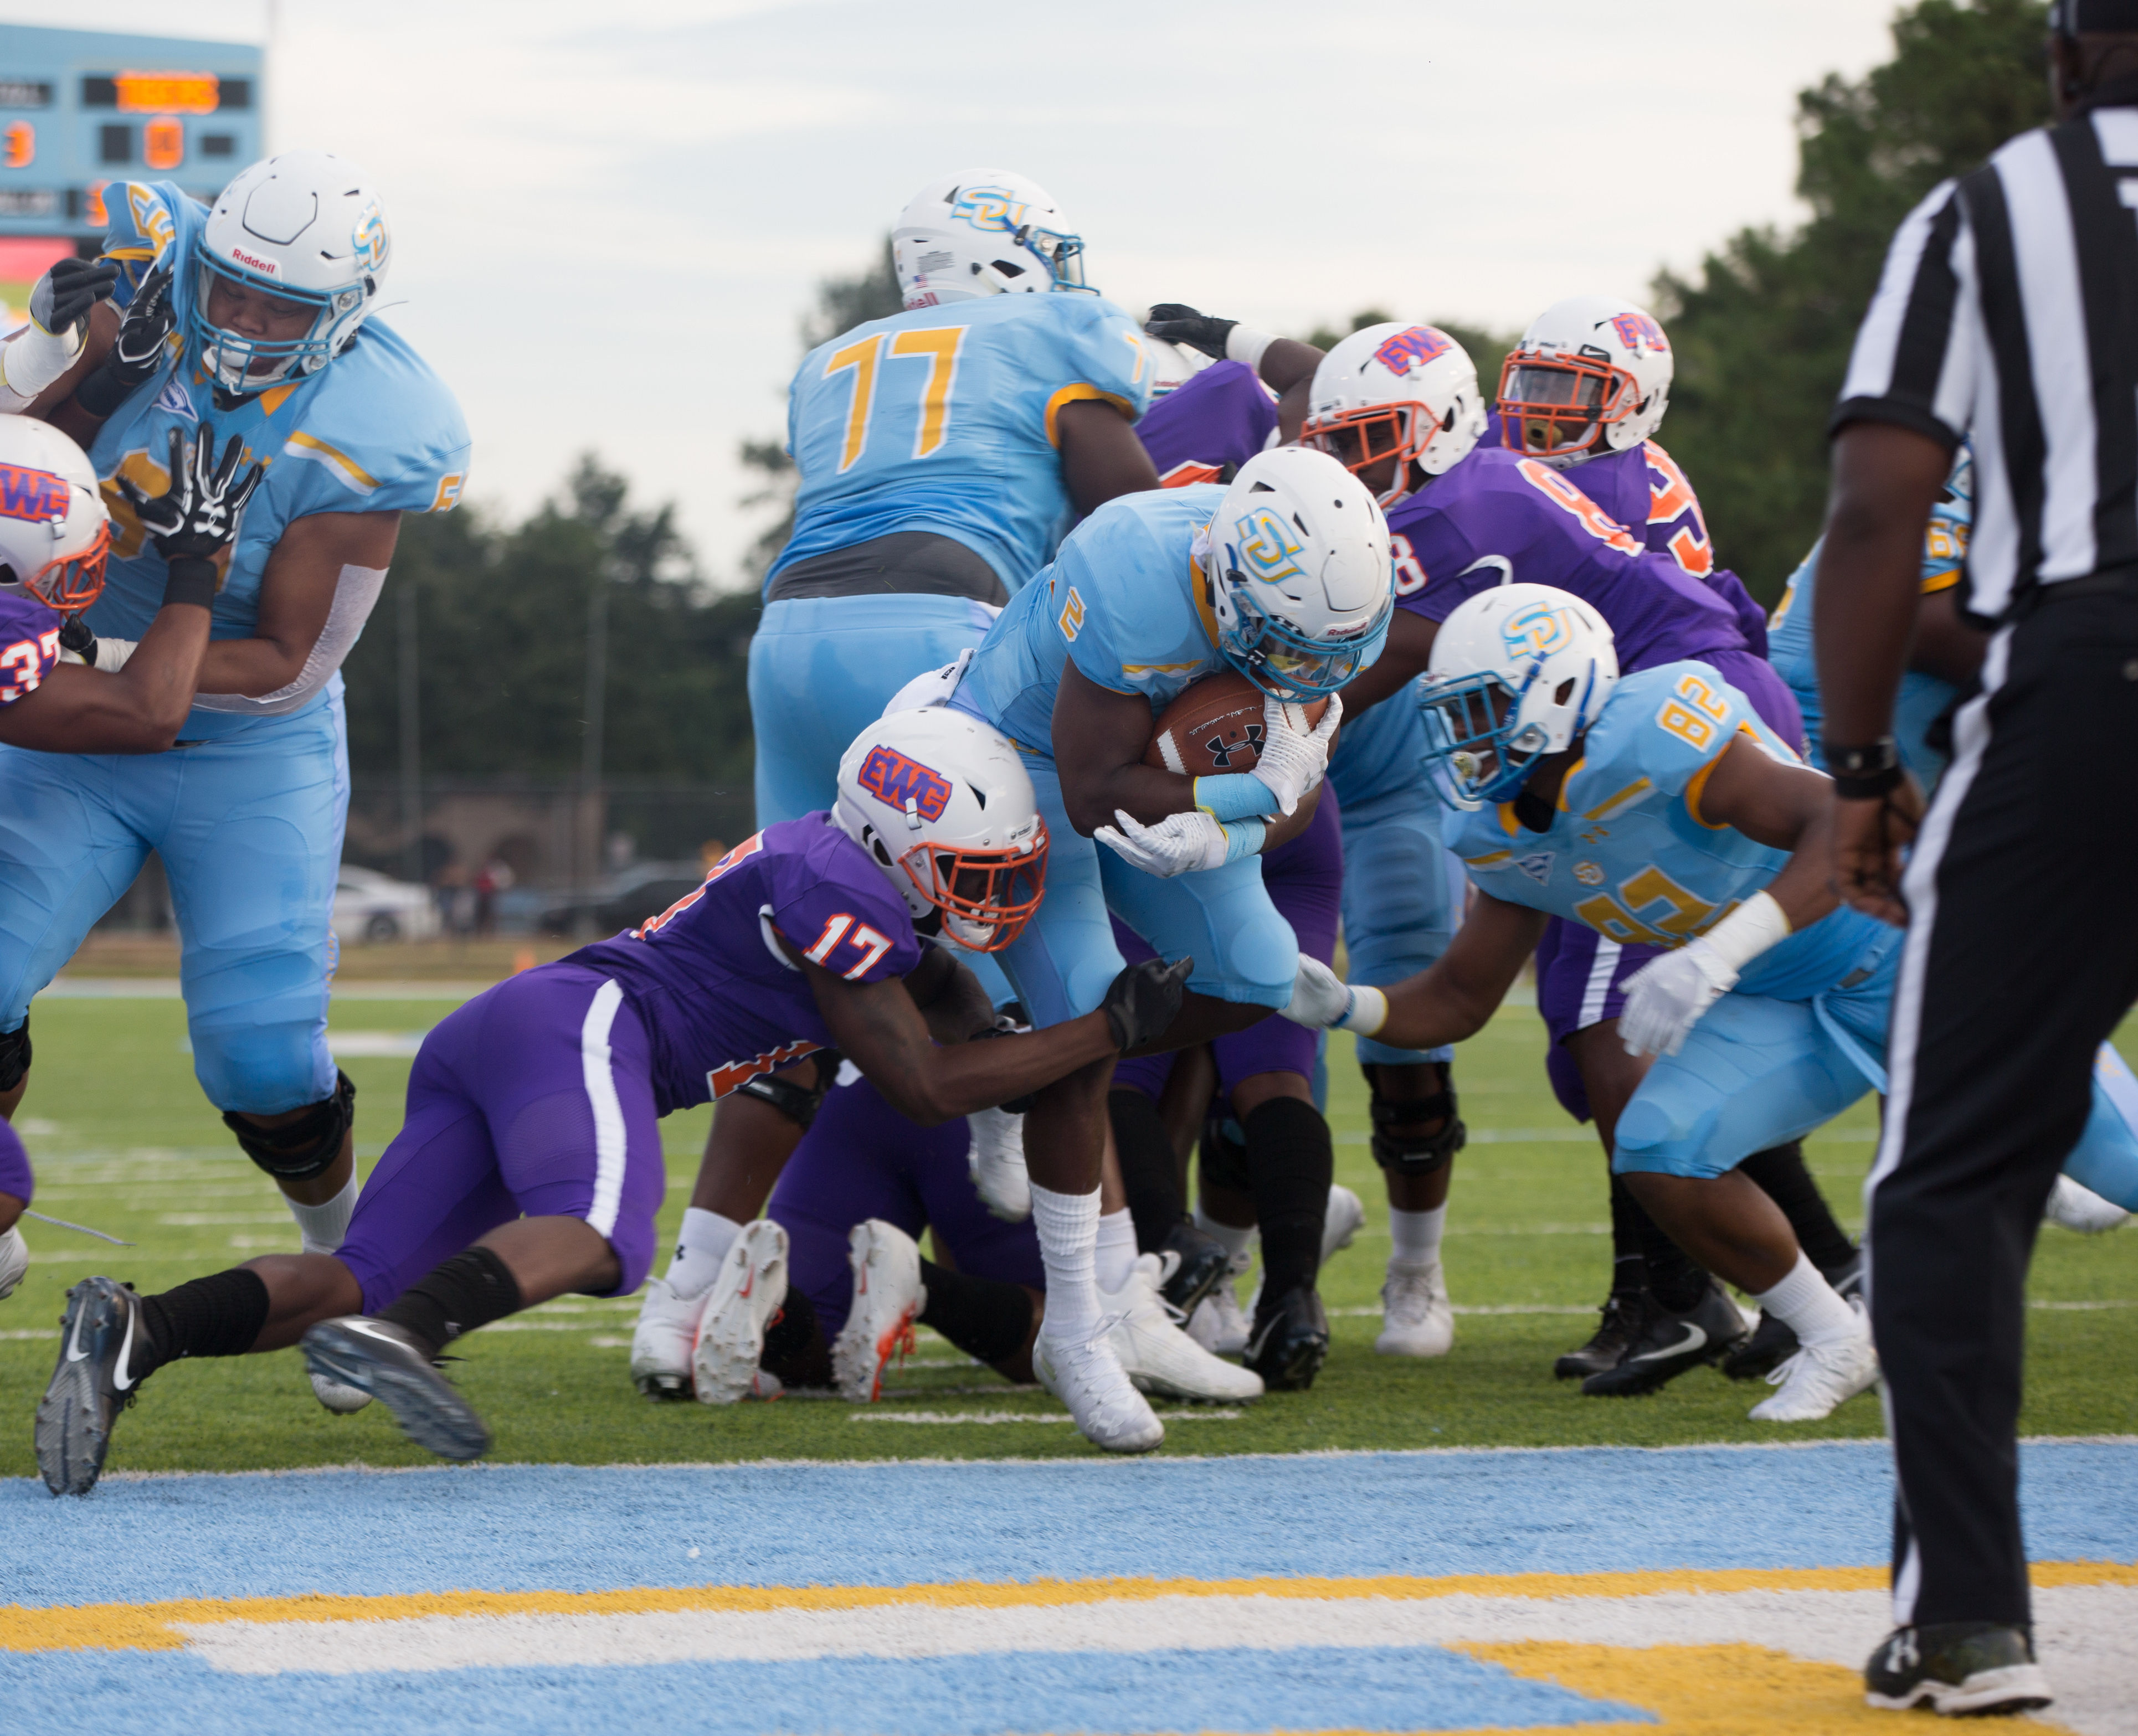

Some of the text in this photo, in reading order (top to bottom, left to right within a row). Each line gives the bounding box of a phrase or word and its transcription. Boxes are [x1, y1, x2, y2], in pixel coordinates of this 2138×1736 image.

[233, 249, 275, 274] Riddell
[821, 324, 973, 475] 77
[0, 462, 69, 524] WC
[1057, 586, 1087, 642] 2
[1654, 673, 1733, 754] 82
[801, 912, 895, 981] 17
